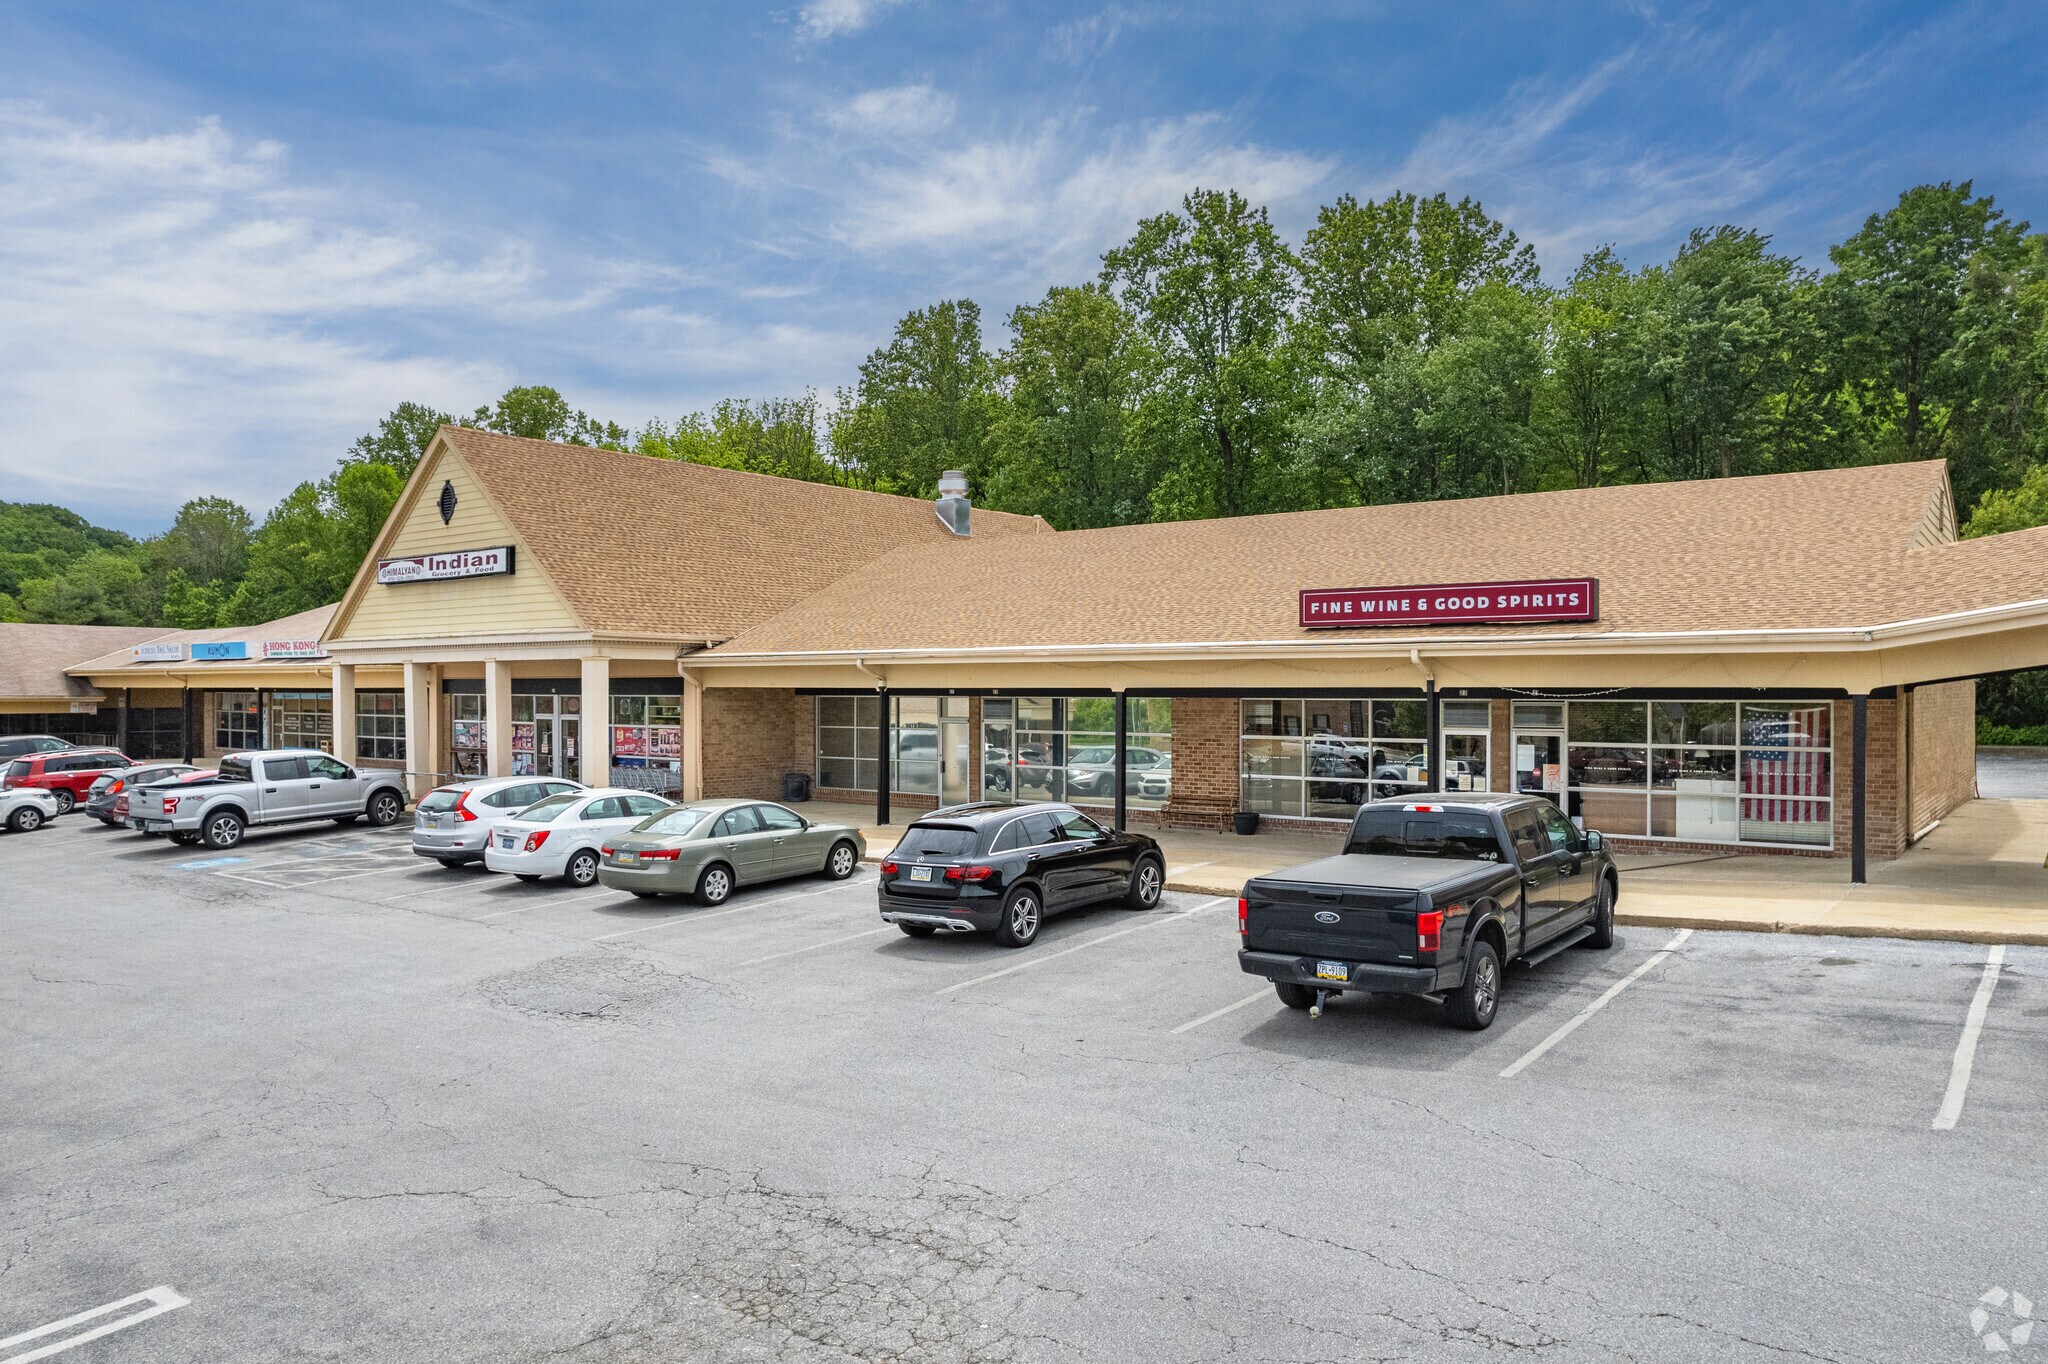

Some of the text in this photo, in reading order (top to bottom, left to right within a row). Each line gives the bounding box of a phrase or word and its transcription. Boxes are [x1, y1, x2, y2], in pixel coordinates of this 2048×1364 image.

[428, 553, 498, 571] Indian
[387, 566, 416, 577] HIMALYAN
[431, 570, 461, 578] Grocery
[1311, 593, 1580, 614] FINE WINE & GOOD SPIRITS
[269, 641, 291, 651] HONG
[292, 641, 316, 650] KONG
